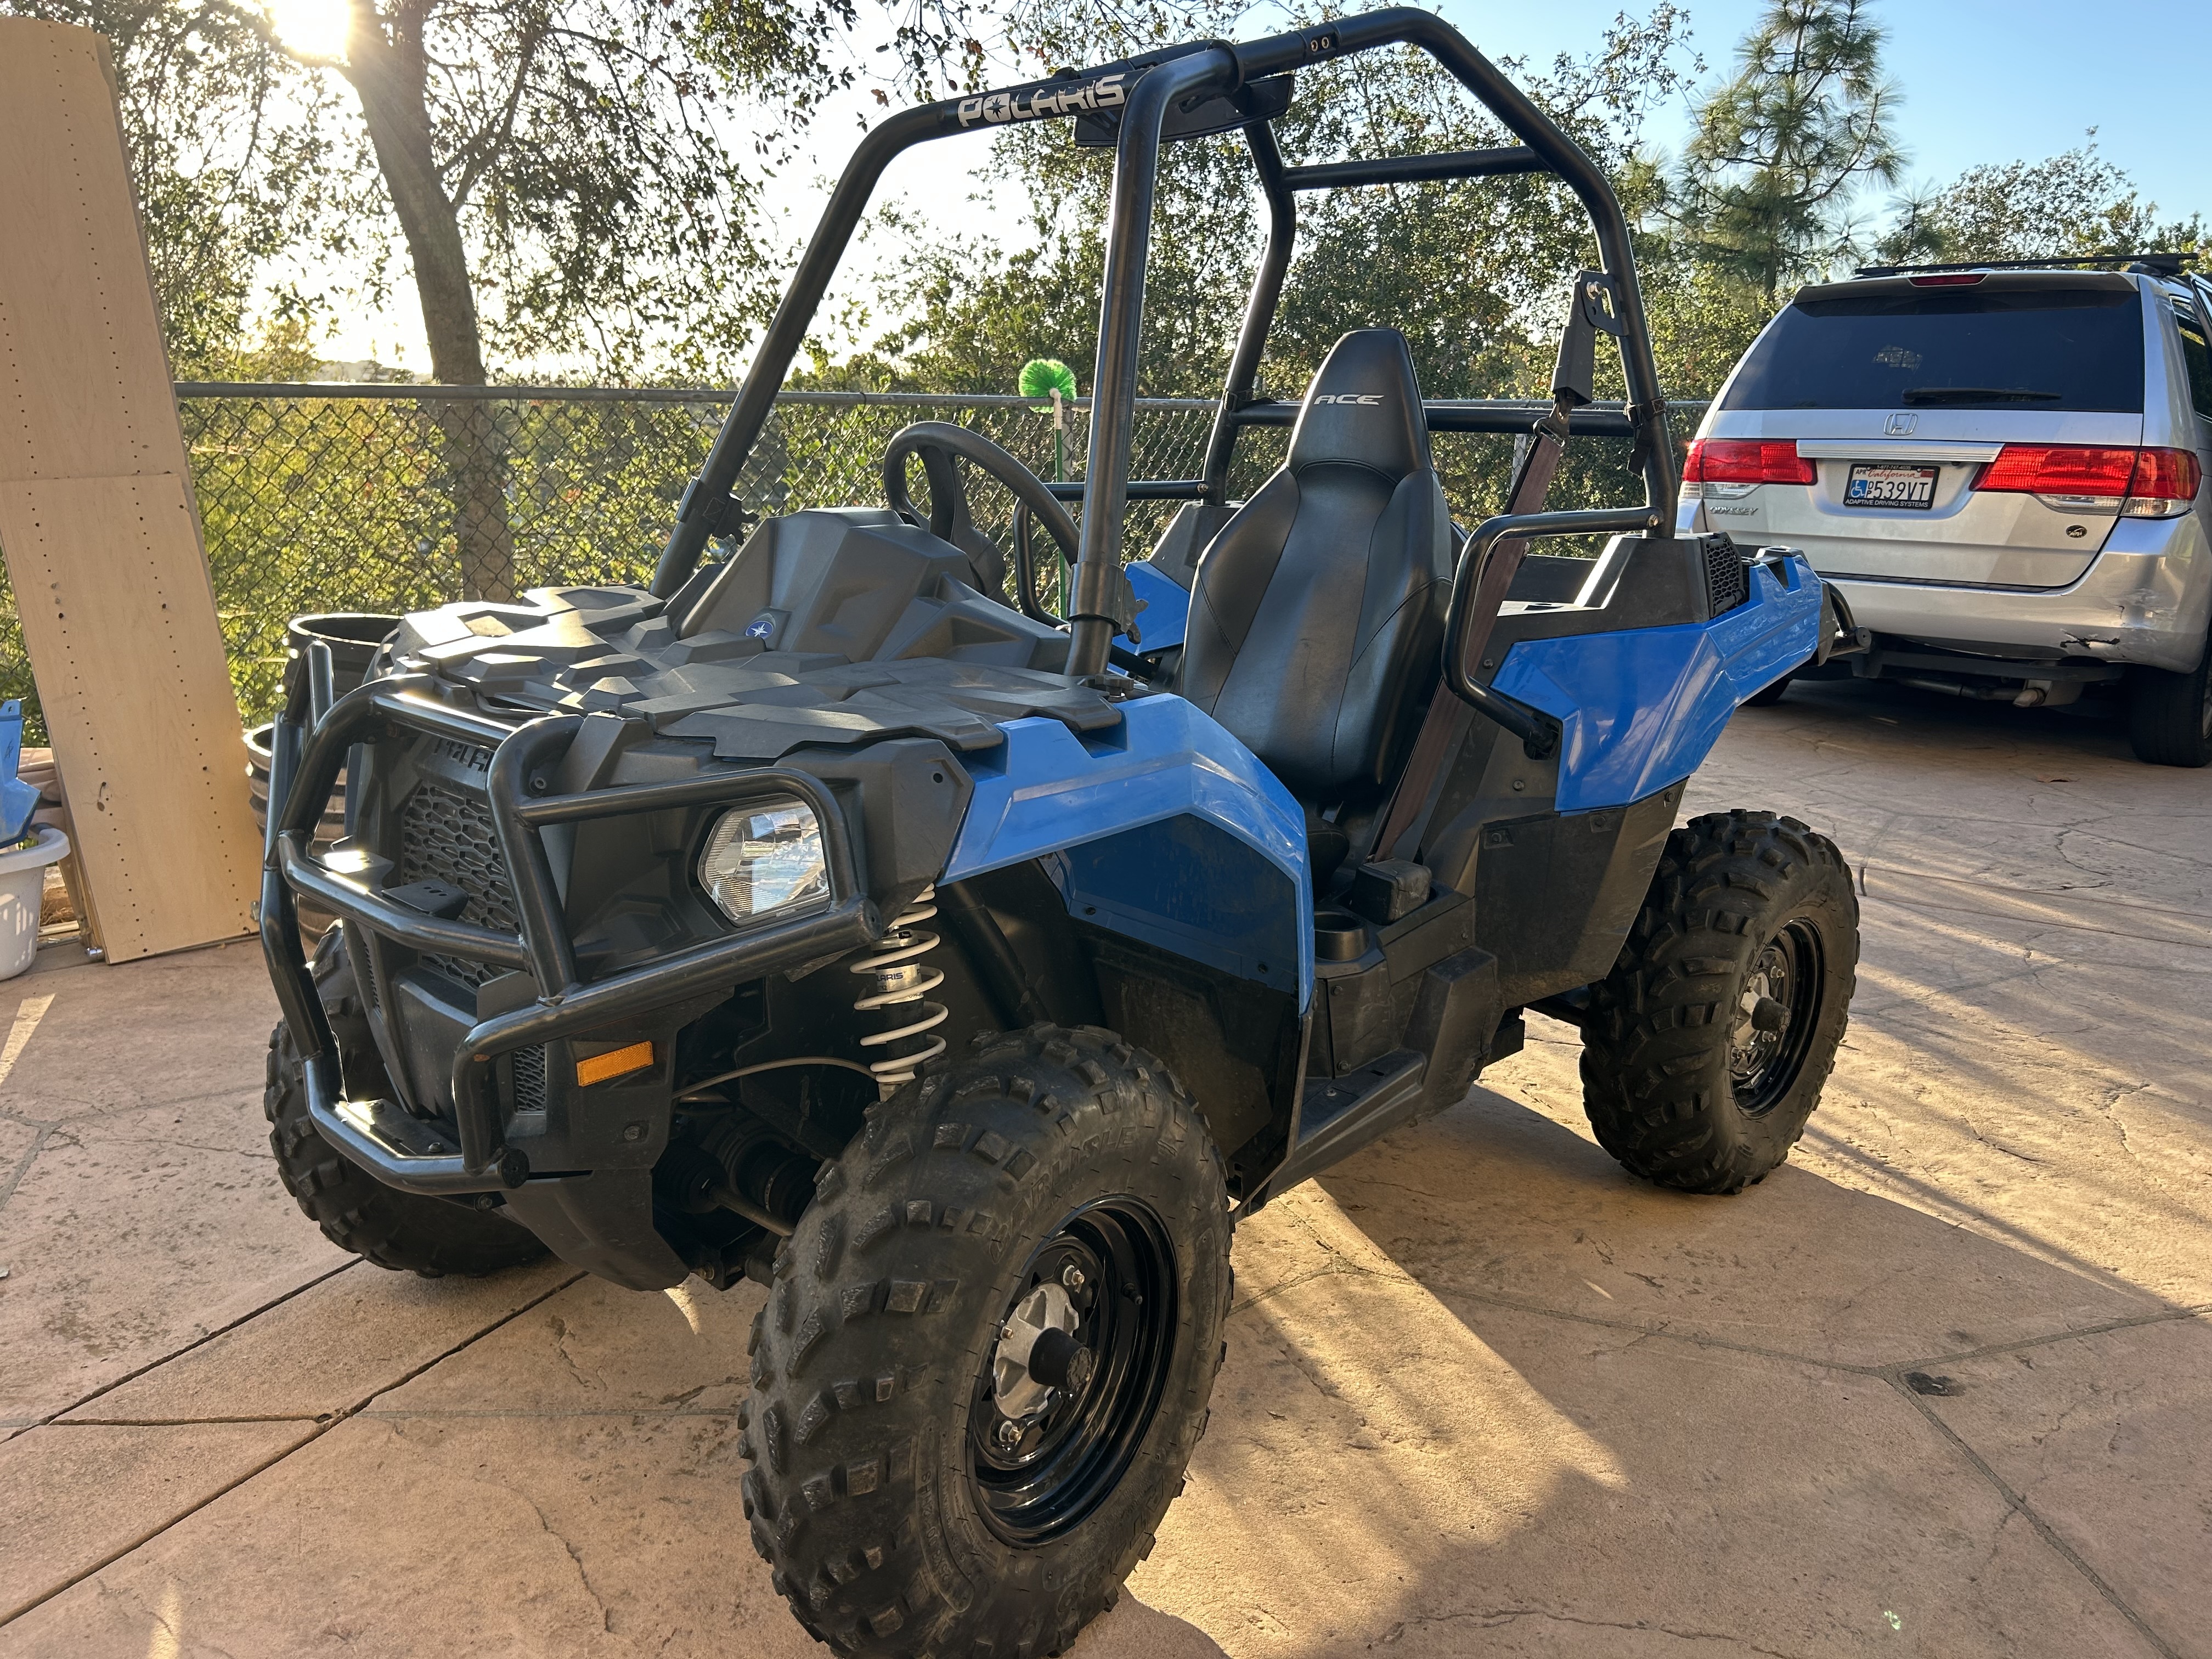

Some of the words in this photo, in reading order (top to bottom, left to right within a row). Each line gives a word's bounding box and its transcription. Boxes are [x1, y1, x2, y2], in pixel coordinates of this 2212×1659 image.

[957, 74, 1125, 127] POLARIS
[1314, 394, 1384, 405] ACE
[1867, 469, 1920, 481] California
[1874, 481, 1928, 501] 539VT
[1709, 506, 1759, 516] ODYSSEY
[877, 972, 904, 982] LARIS
